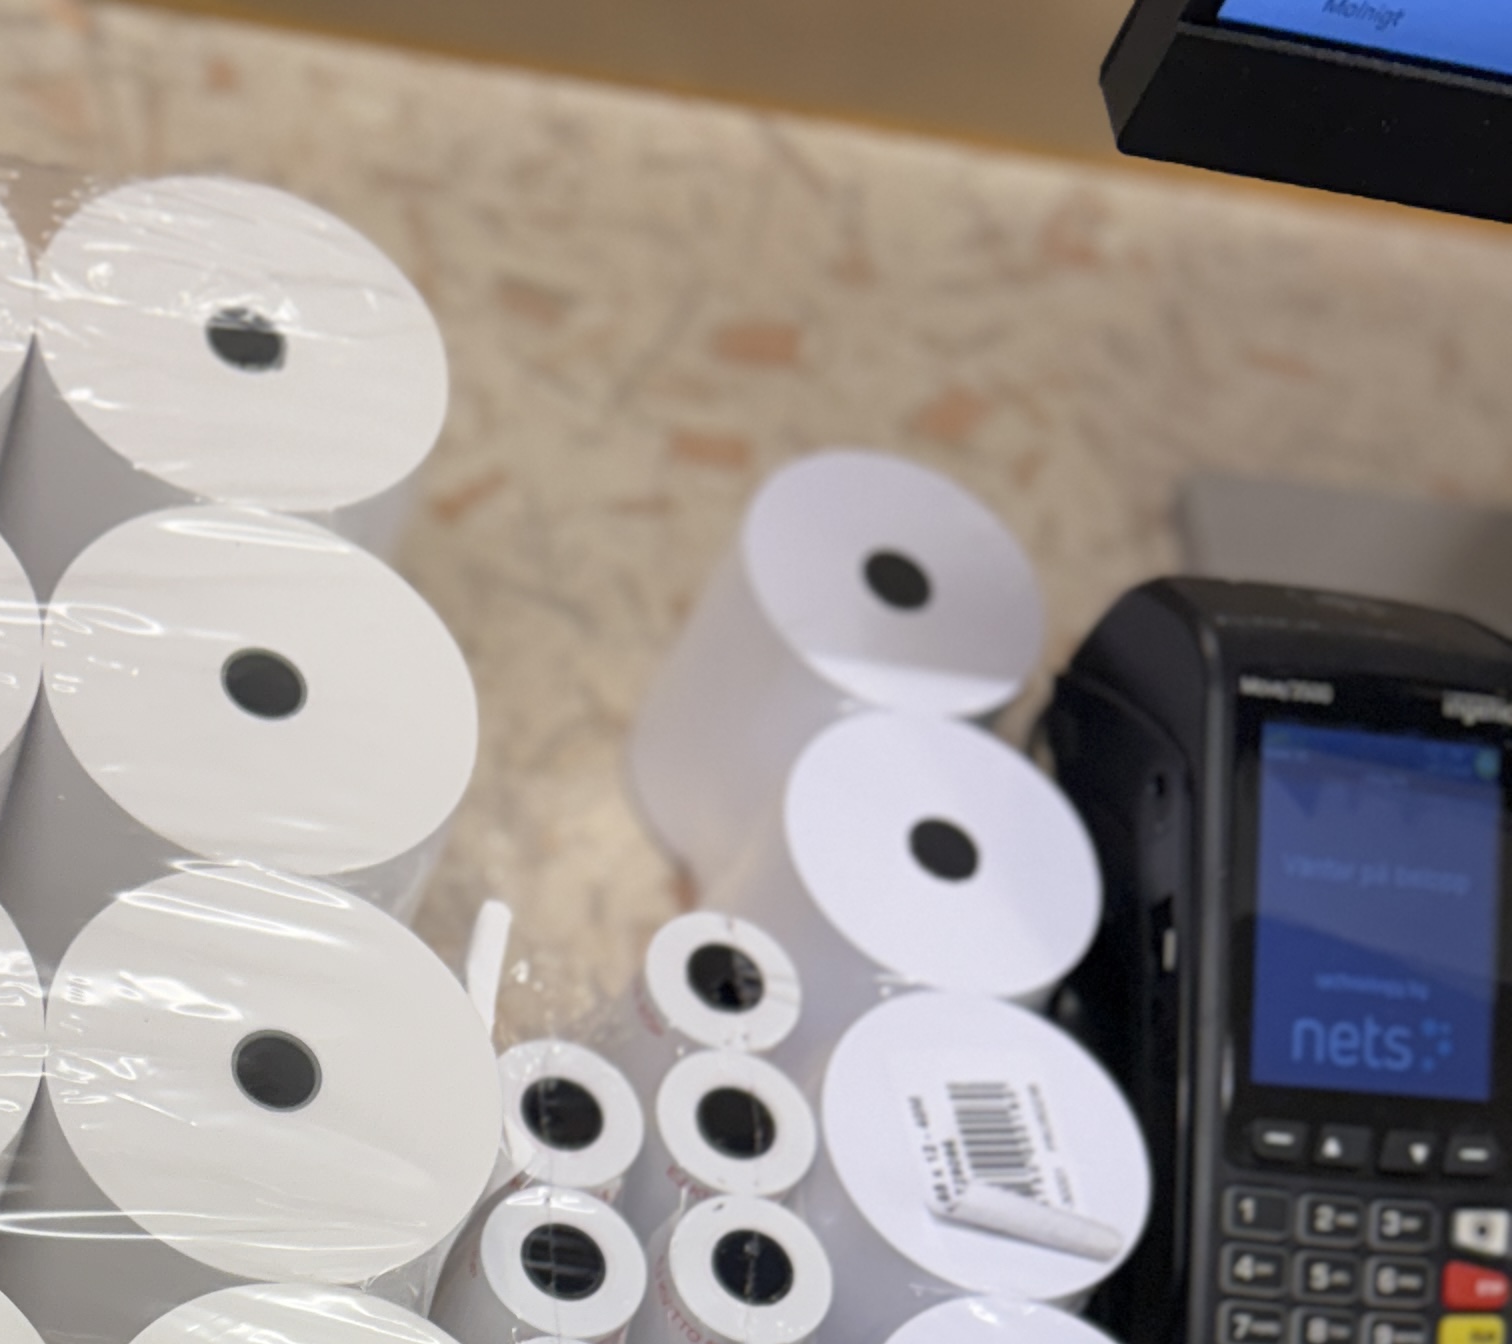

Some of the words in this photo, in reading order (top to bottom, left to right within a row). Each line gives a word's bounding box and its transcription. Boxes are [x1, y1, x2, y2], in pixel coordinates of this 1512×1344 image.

[1291, 1012, 1414, 1072] nets
[1238, 1196, 1255, 1224] 1
[1313, 1204, 1335, 1232] 2
[1233, 1254, 1254, 1281] 4
[1232, 1313, 1252, 1340] 7
